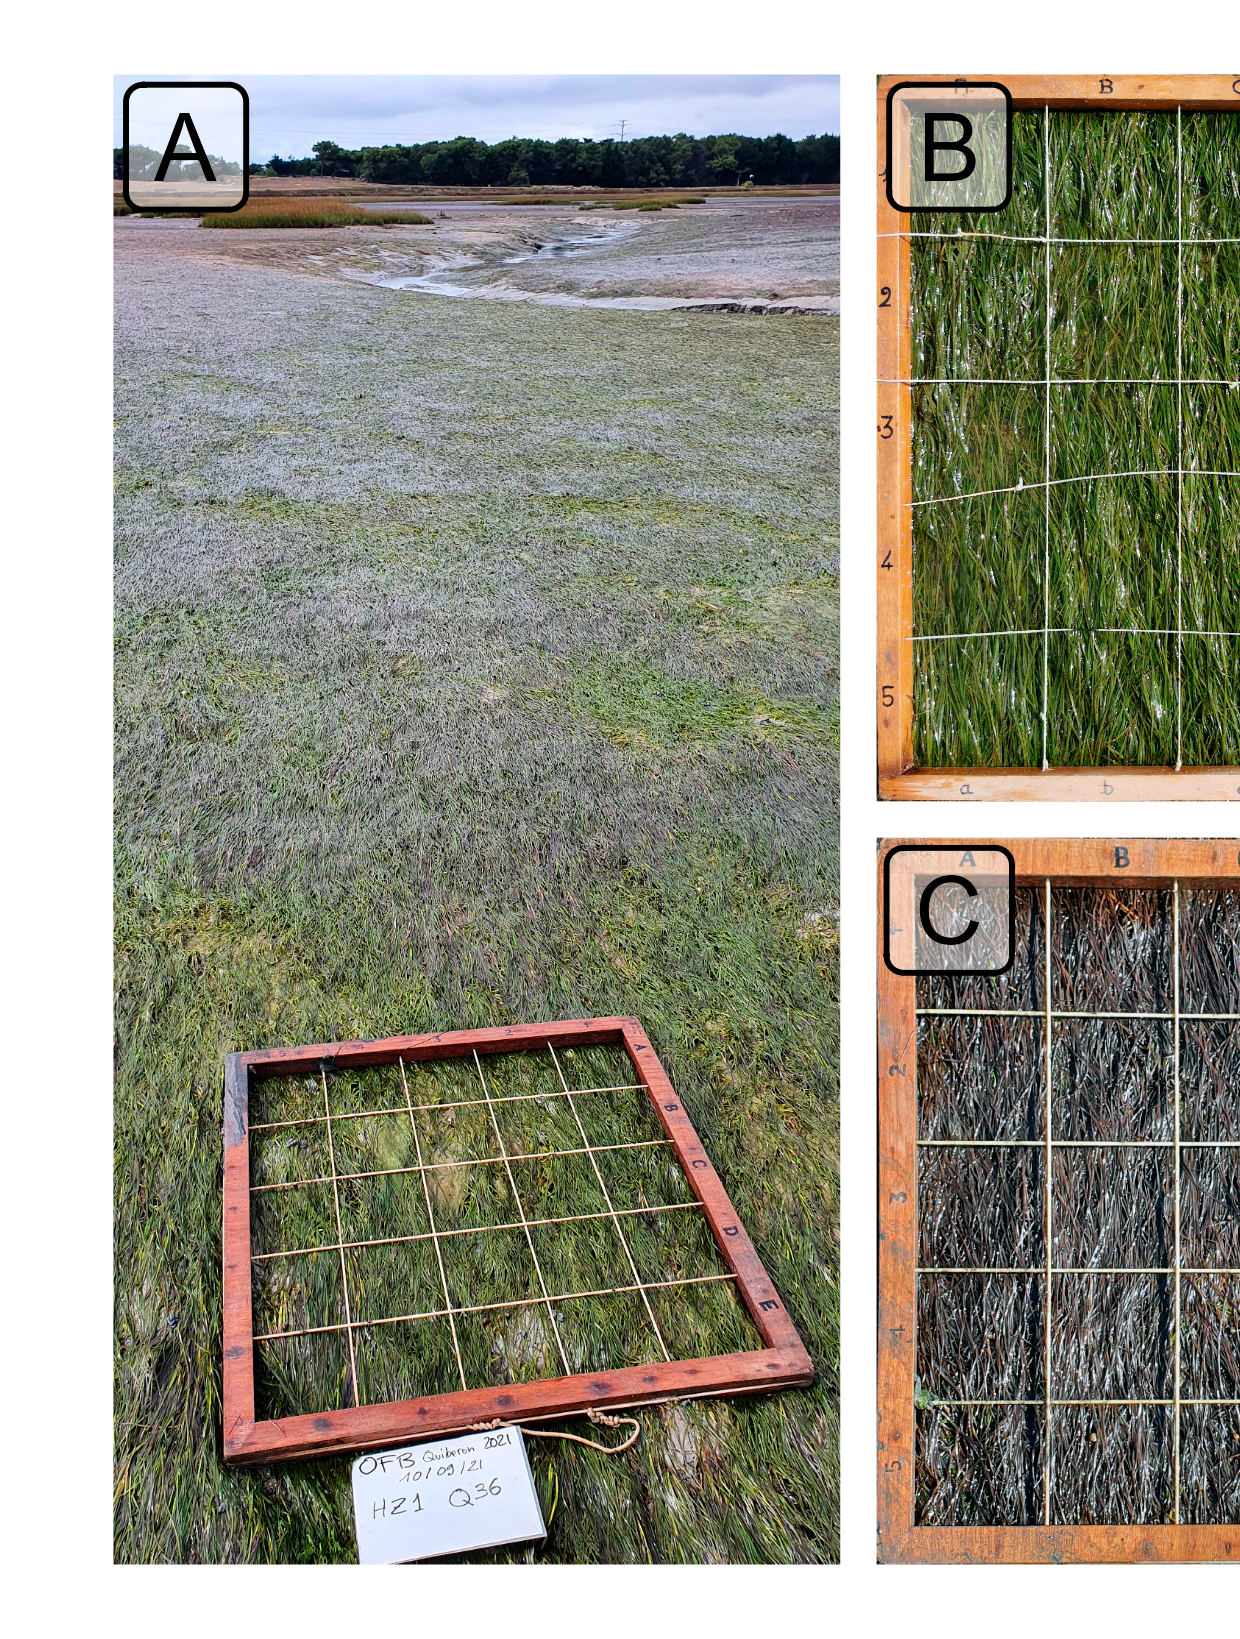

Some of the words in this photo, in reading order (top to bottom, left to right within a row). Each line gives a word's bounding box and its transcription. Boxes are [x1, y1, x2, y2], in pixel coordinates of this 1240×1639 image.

[1100, 79, 1114, 95] B
[879, 286, 892, 307] 2
[880, 415, 894, 439] 3
[881, 549, 893, 571] 4
[882, 685, 895, 707] 5
[960, 783, 974, 795] a
[1102, 780, 1115, 796] b
[959, 850, 976, 867] A
[1114, 846, 1130, 868] B
[633, 1044, 647, 1052] A
[889, 1063, 907, 1077] 2
[664, 1104, 679, 1113] B
[692, 1160, 708, 1169] C
[722, 1225, 739, 1237] D
[759, 1299, 779, 1312] E
[358, 1452, 416, 1476] OFB
[422, 1446, 475, 1464] Quiberon
[484, 1433, 512, 1450] 2021
[373, 1492, 424, 1519] HZ1
